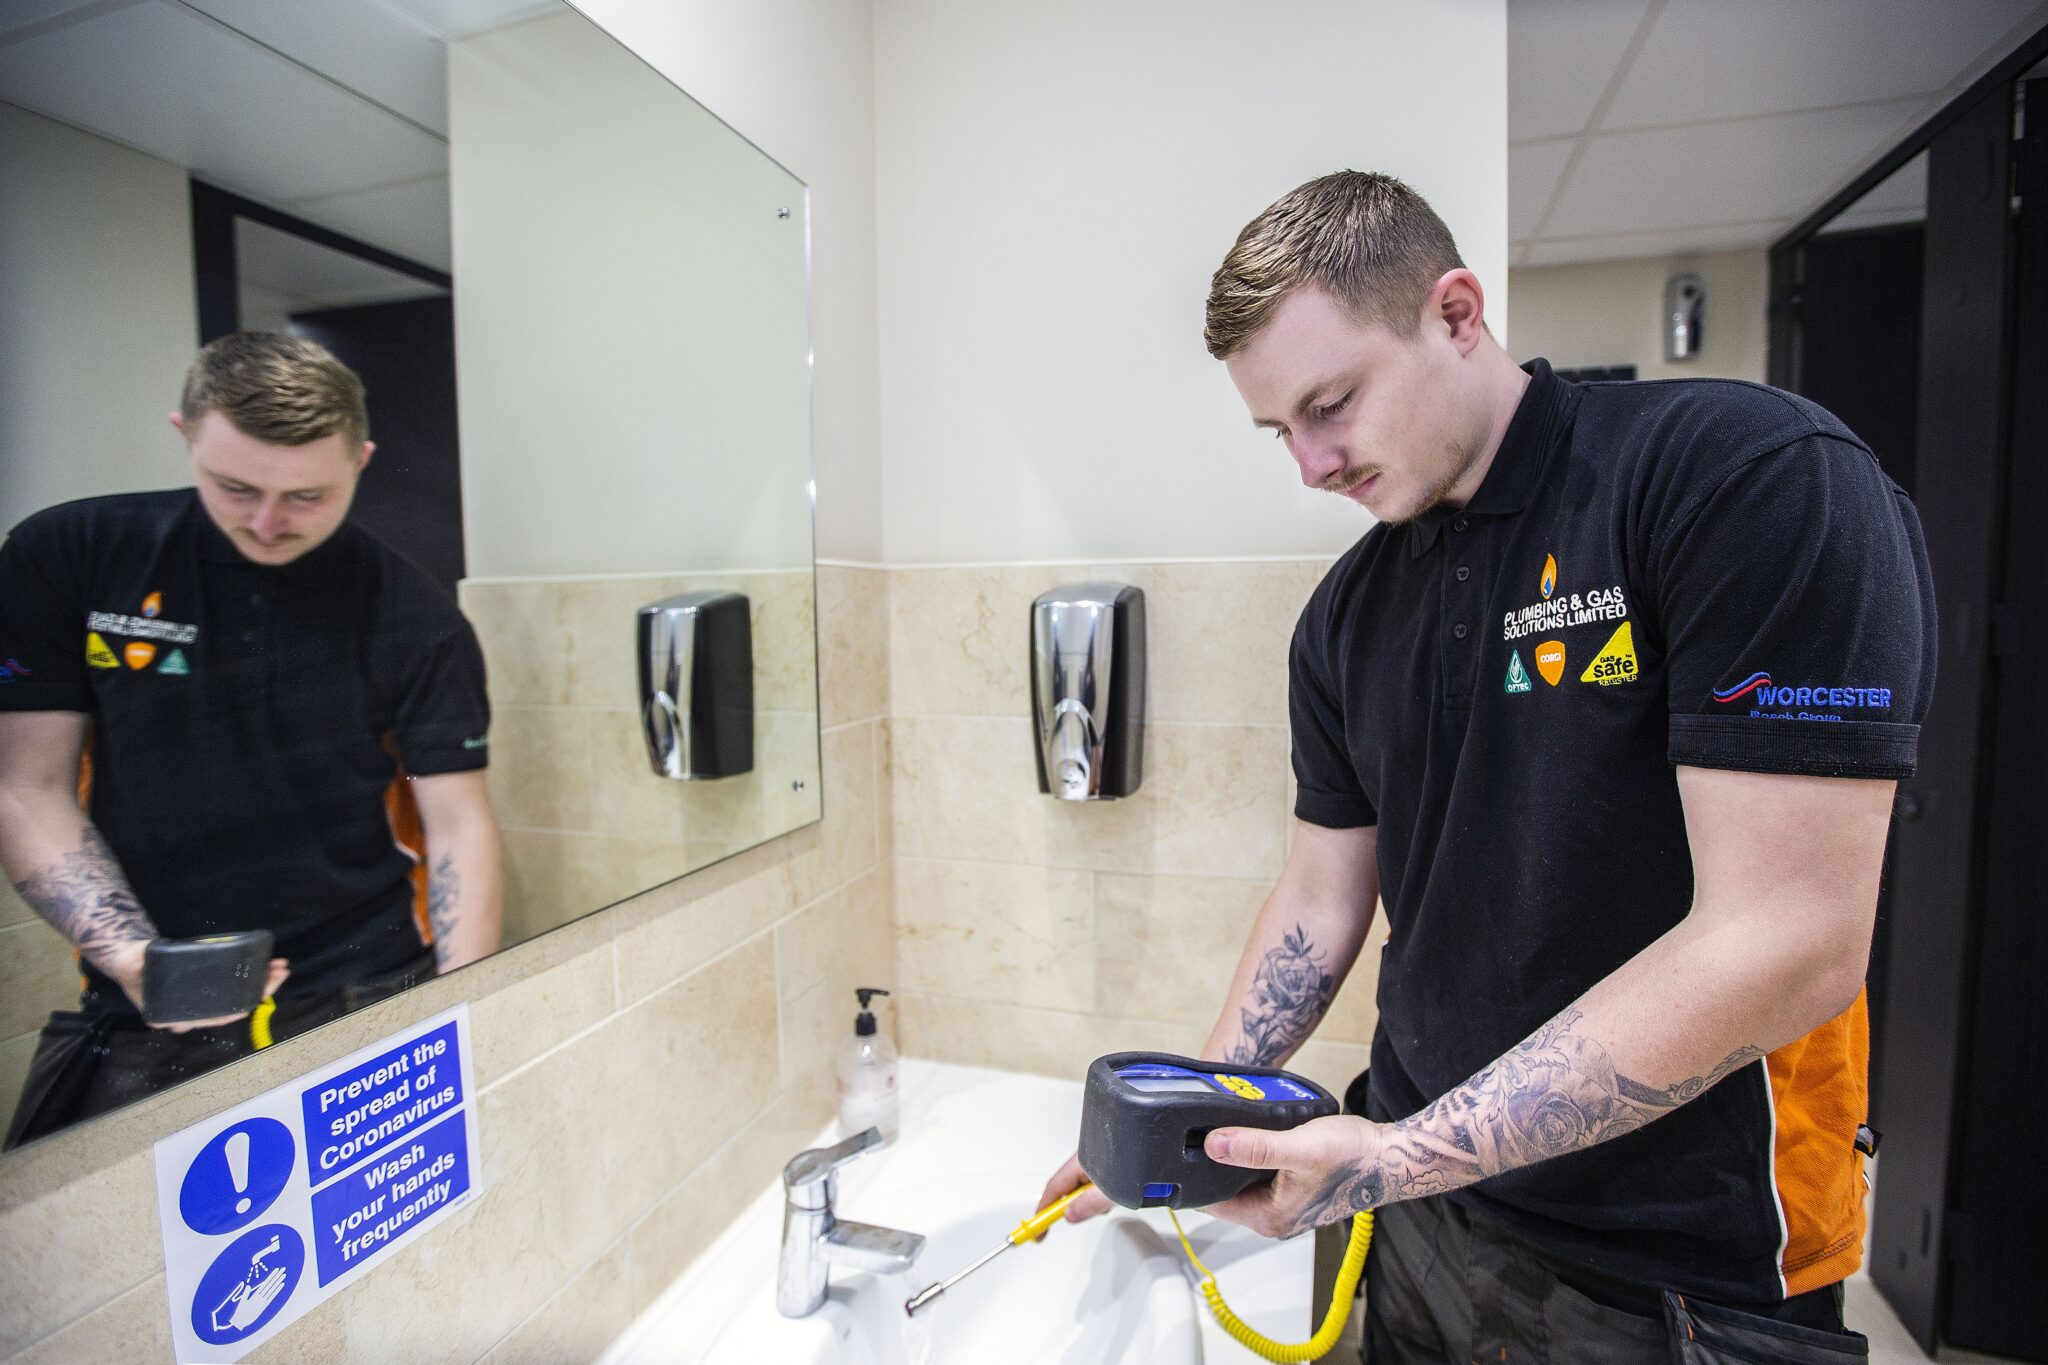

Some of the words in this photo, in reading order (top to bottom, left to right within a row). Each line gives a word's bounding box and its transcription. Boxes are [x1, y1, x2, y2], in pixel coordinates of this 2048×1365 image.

[1504, 597, 1567, 627] PLUMBING
[1571, 594, 1584, 611] &
[1587, 586, 1624, 607] GAS
[1504, 613, 1564, 640] SOLUTIONS
[1567, 603, 1627, 626] LIMITED
[1540, 652, 1561, 663] CORGI
[1593, 657, 1634, 678] safe
[1507, 682, 1529, 692] OFTEC
[1756, 686, 1891, 708] WORCESTER
[319, 1054, 410, 1113] Prevent
[413, 1038, 447, 1067] the
[330, 1084, 410, 1137] spread
[415, 1065, 437, 1091] of
[319, 1084, 455, 1170] Coronavirus
[363, 1144, 425, 1190] Wash
[332, 1193, 386, 1244] your
[392, 1152, 456, 1204] hands
[341, 1179, 451, 1262] frequently
